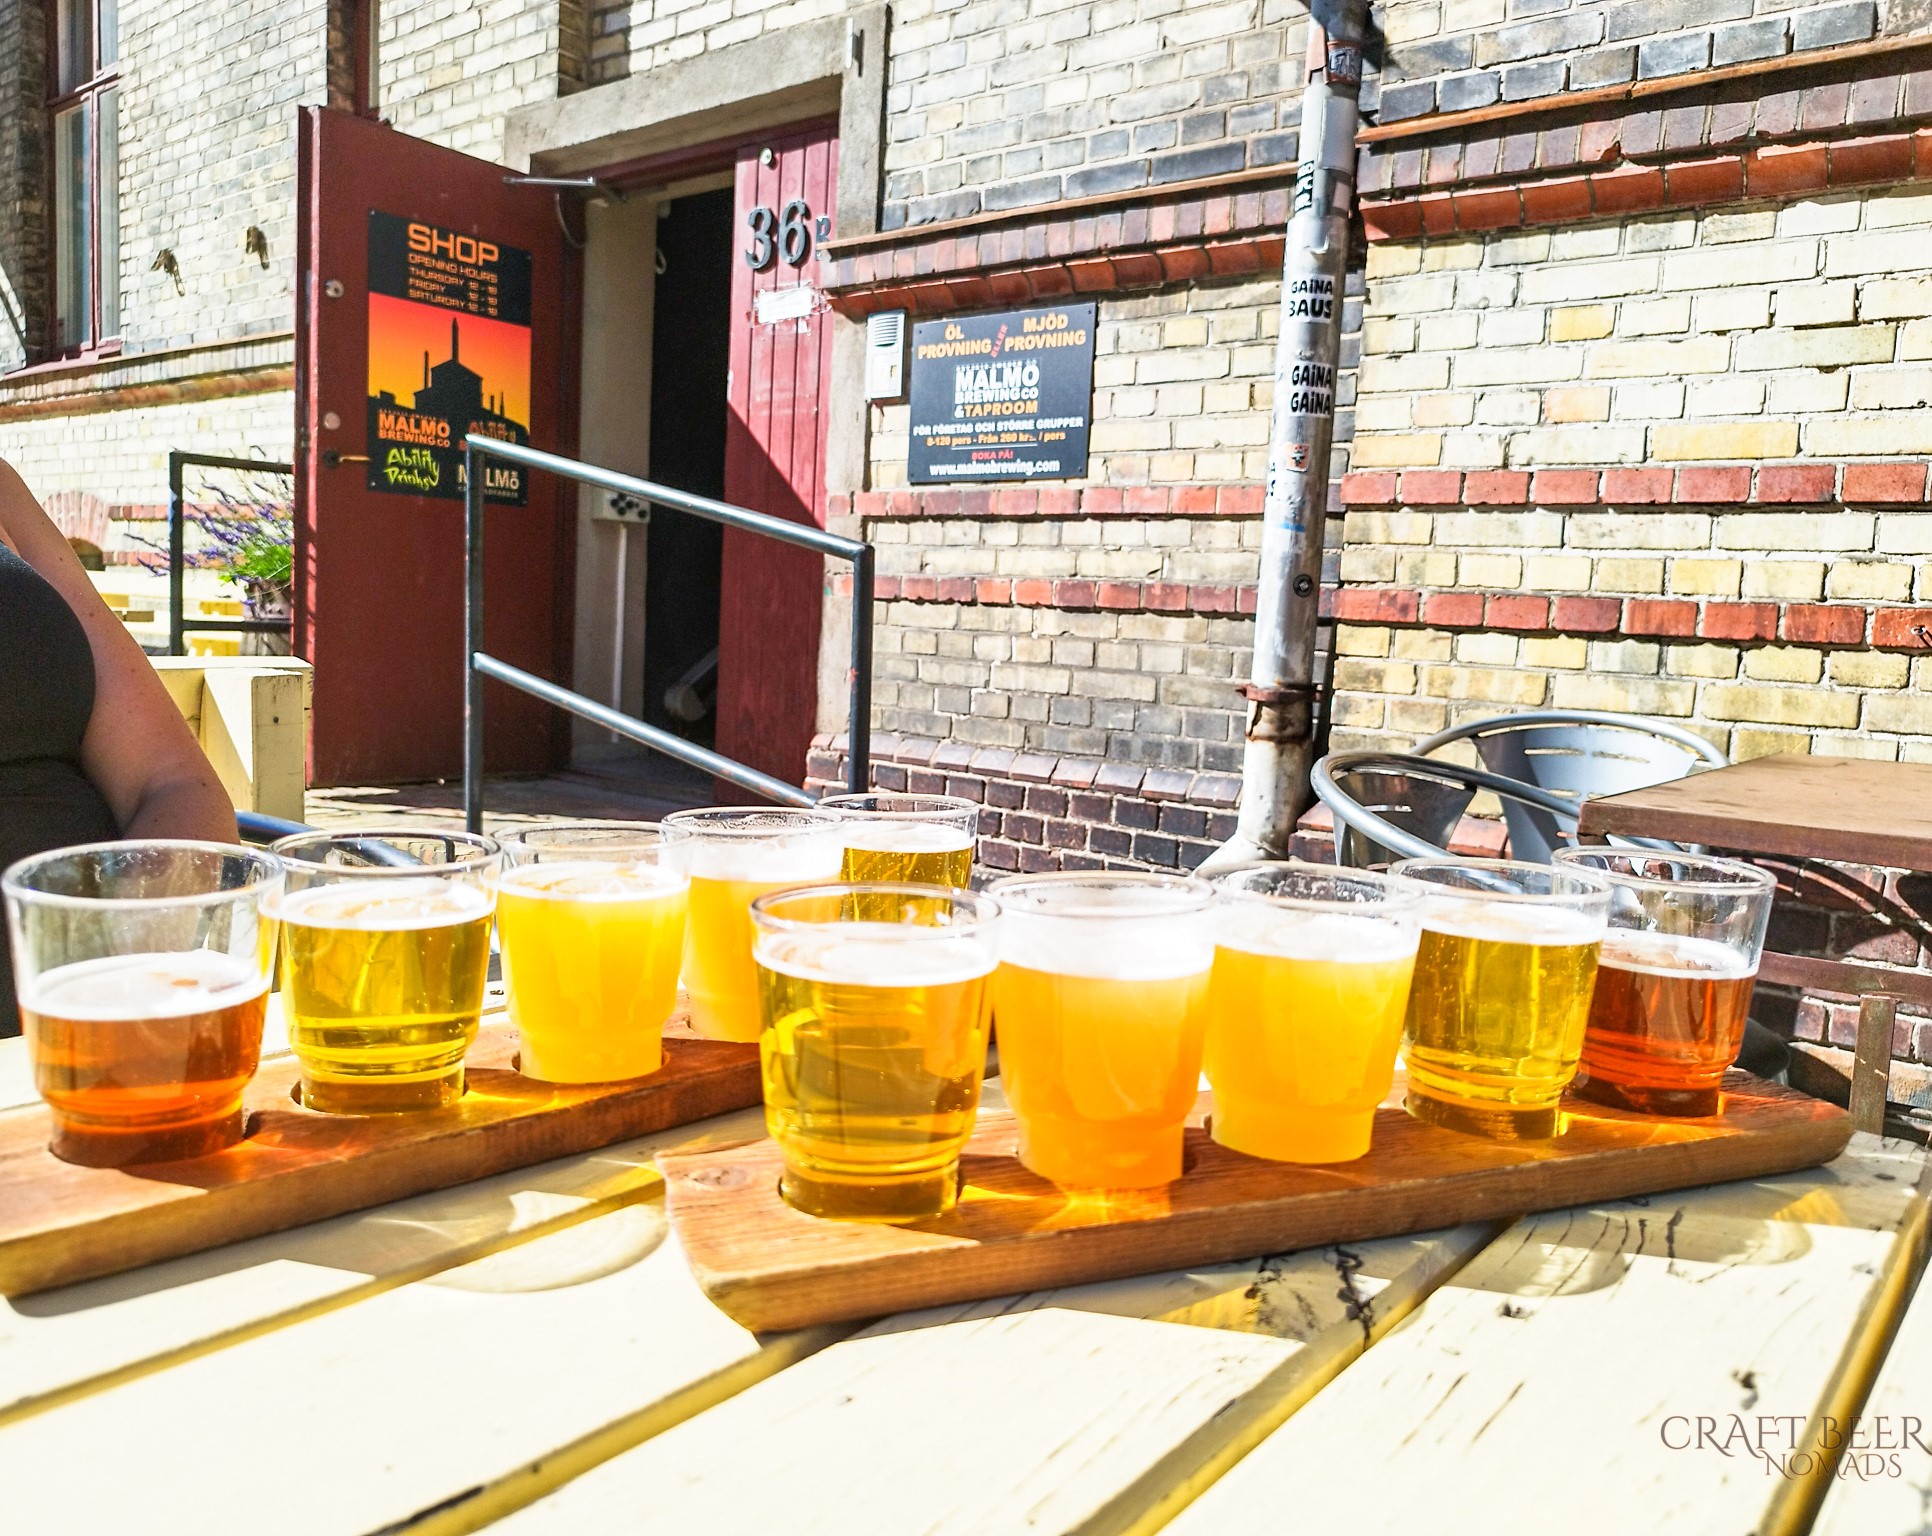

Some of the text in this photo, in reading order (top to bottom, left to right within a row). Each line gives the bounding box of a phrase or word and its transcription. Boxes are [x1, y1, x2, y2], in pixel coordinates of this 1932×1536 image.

[407, 223, 499, 266] SHOP
[745, 200, 806, 269] 36
[408, 253, 498, 283] OPENING HOURS
[408, 267, 465, 287] THURSDAY
[408, 277, 446, 293] FRIDAY
[408, 289, 465, 309] SATURDAY
[945, 323, 965, 341] ÖL
[1023, 313, 1069, 333] MJÖD
[918, 338, 992, 360] PROVNING
[1004, 330, 1086, 352] PROVNING
[955, 359, 1040, 391] MALMÖ
[955, 387, 1039, 405] BREWING CO
[964, 400, 1039, 418] TAPROOM
[913, 423, 932, 437] FÖR
[932, 421, 974, 436] FÖRETAG
[975, 420, 995, 433] OCH
[1036, 416, 1084, 430] GRUPPER
[378, 429, 436, 446] BREWING
[437, 437, 450, 448] CO
[971, 450, 996, 461] BOKA
[387, 448, 440, 486] Ability
[929, 458, 1060, 477] www.malmobrewing.com
